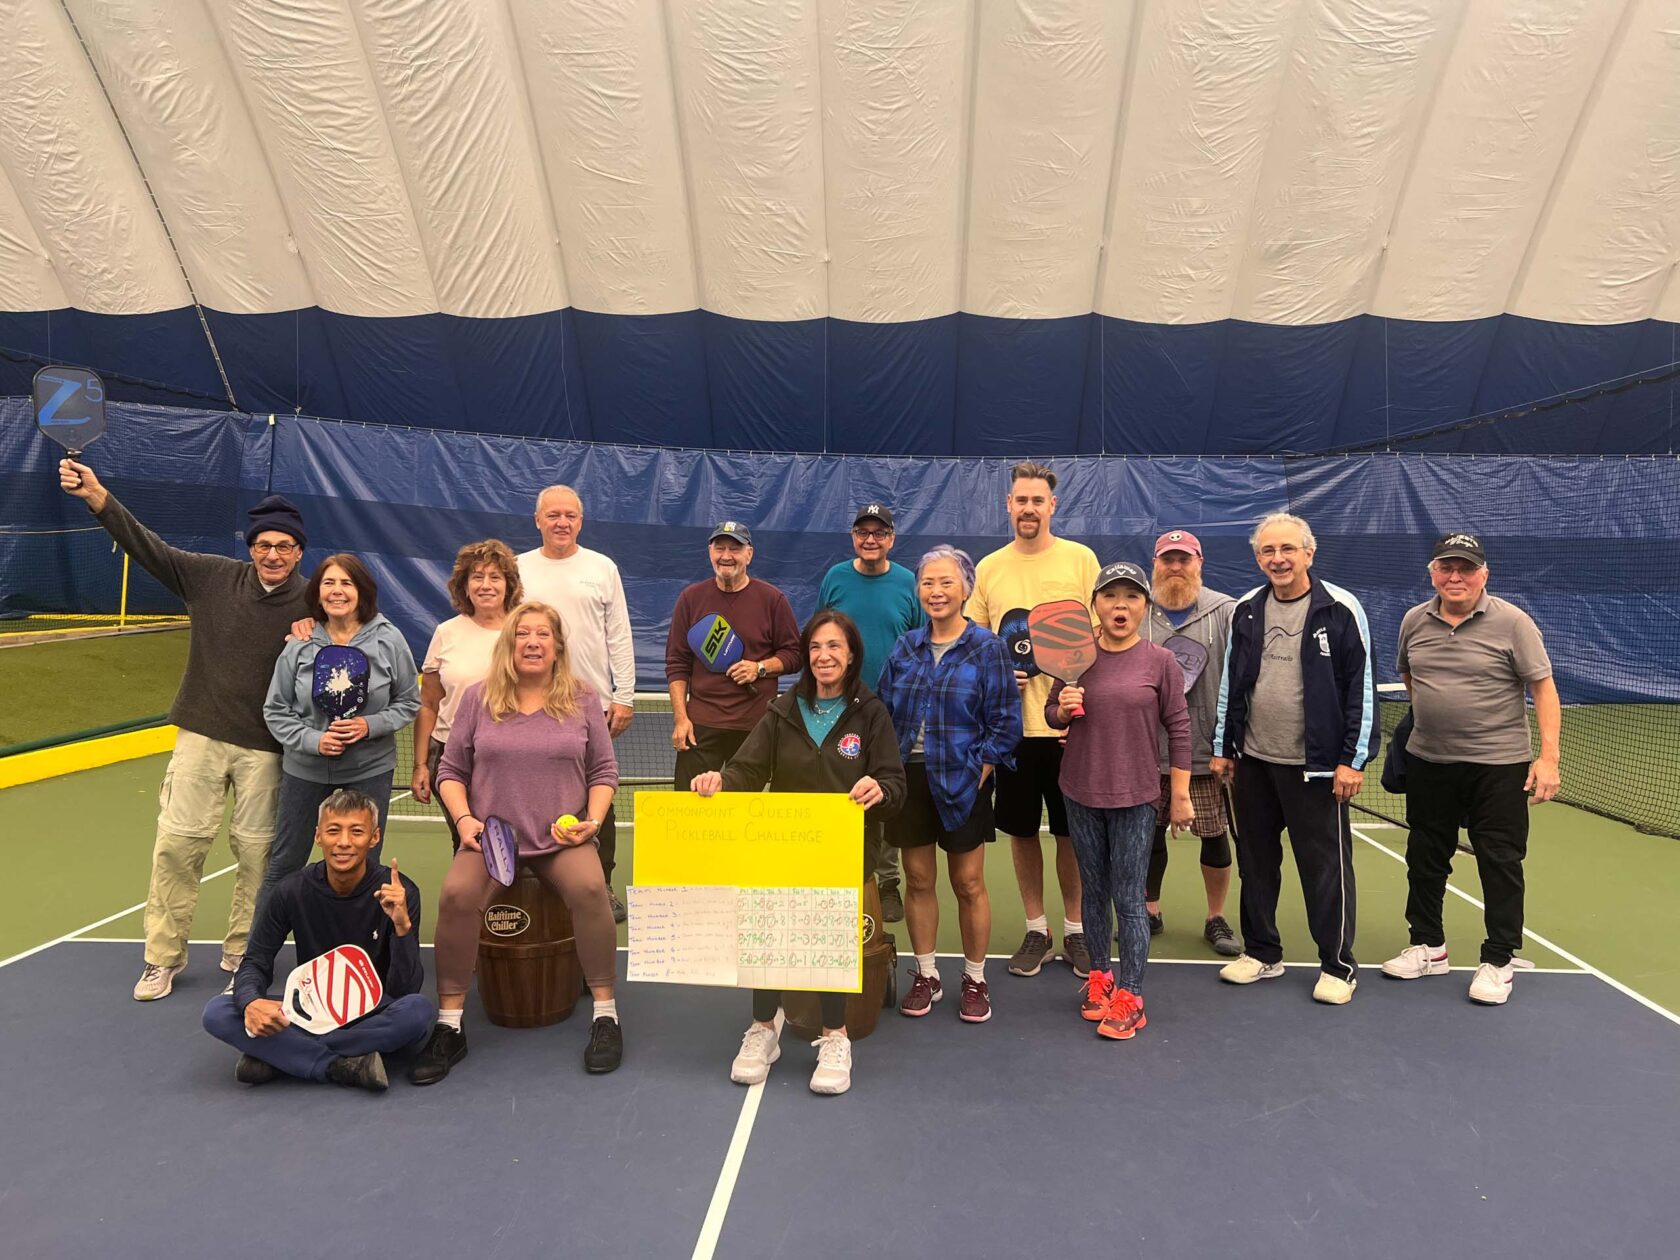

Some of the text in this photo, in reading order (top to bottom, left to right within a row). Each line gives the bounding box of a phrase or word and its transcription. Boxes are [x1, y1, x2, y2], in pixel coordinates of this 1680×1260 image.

[705, 619, 728, 658] SLK
[744, 822, 823, 843] CHALLENGE
[488, 910, 522, 921] Halftime
[491, 921, 518, 931] Chiller
